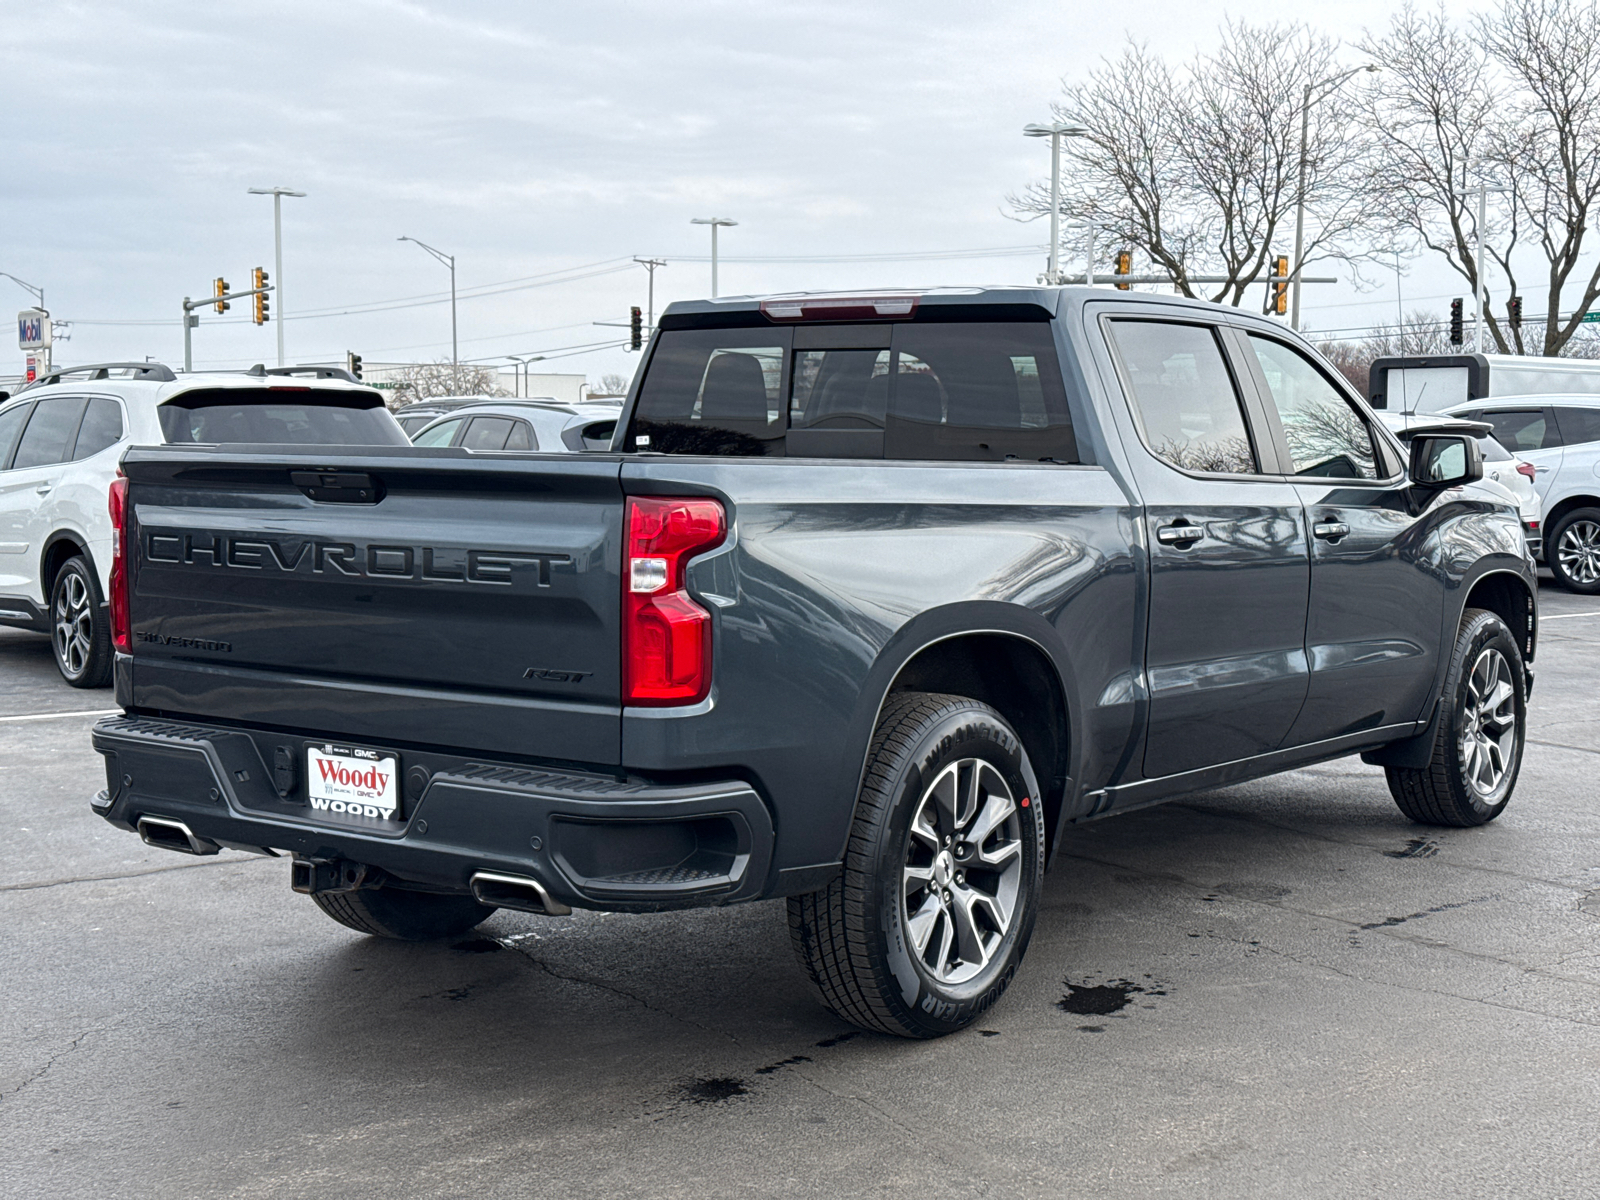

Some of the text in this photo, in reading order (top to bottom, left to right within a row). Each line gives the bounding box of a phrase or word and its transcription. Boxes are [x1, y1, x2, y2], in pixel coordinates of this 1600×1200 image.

[20, 317, 42, 342] Mobil
[361, 382, 411, 390] ARBUCKS
[147, 533, 571, 588] CHEVROLET
[136, 631, 233, 652] SILVERADO
[522, 667, 593, 683] RST
[354, 749, 377, 758] GMC
[315, 758, 390, 797] Woody
[356, 790, 375, 799] GMC
[309, 797, 394, 820] WOODY
